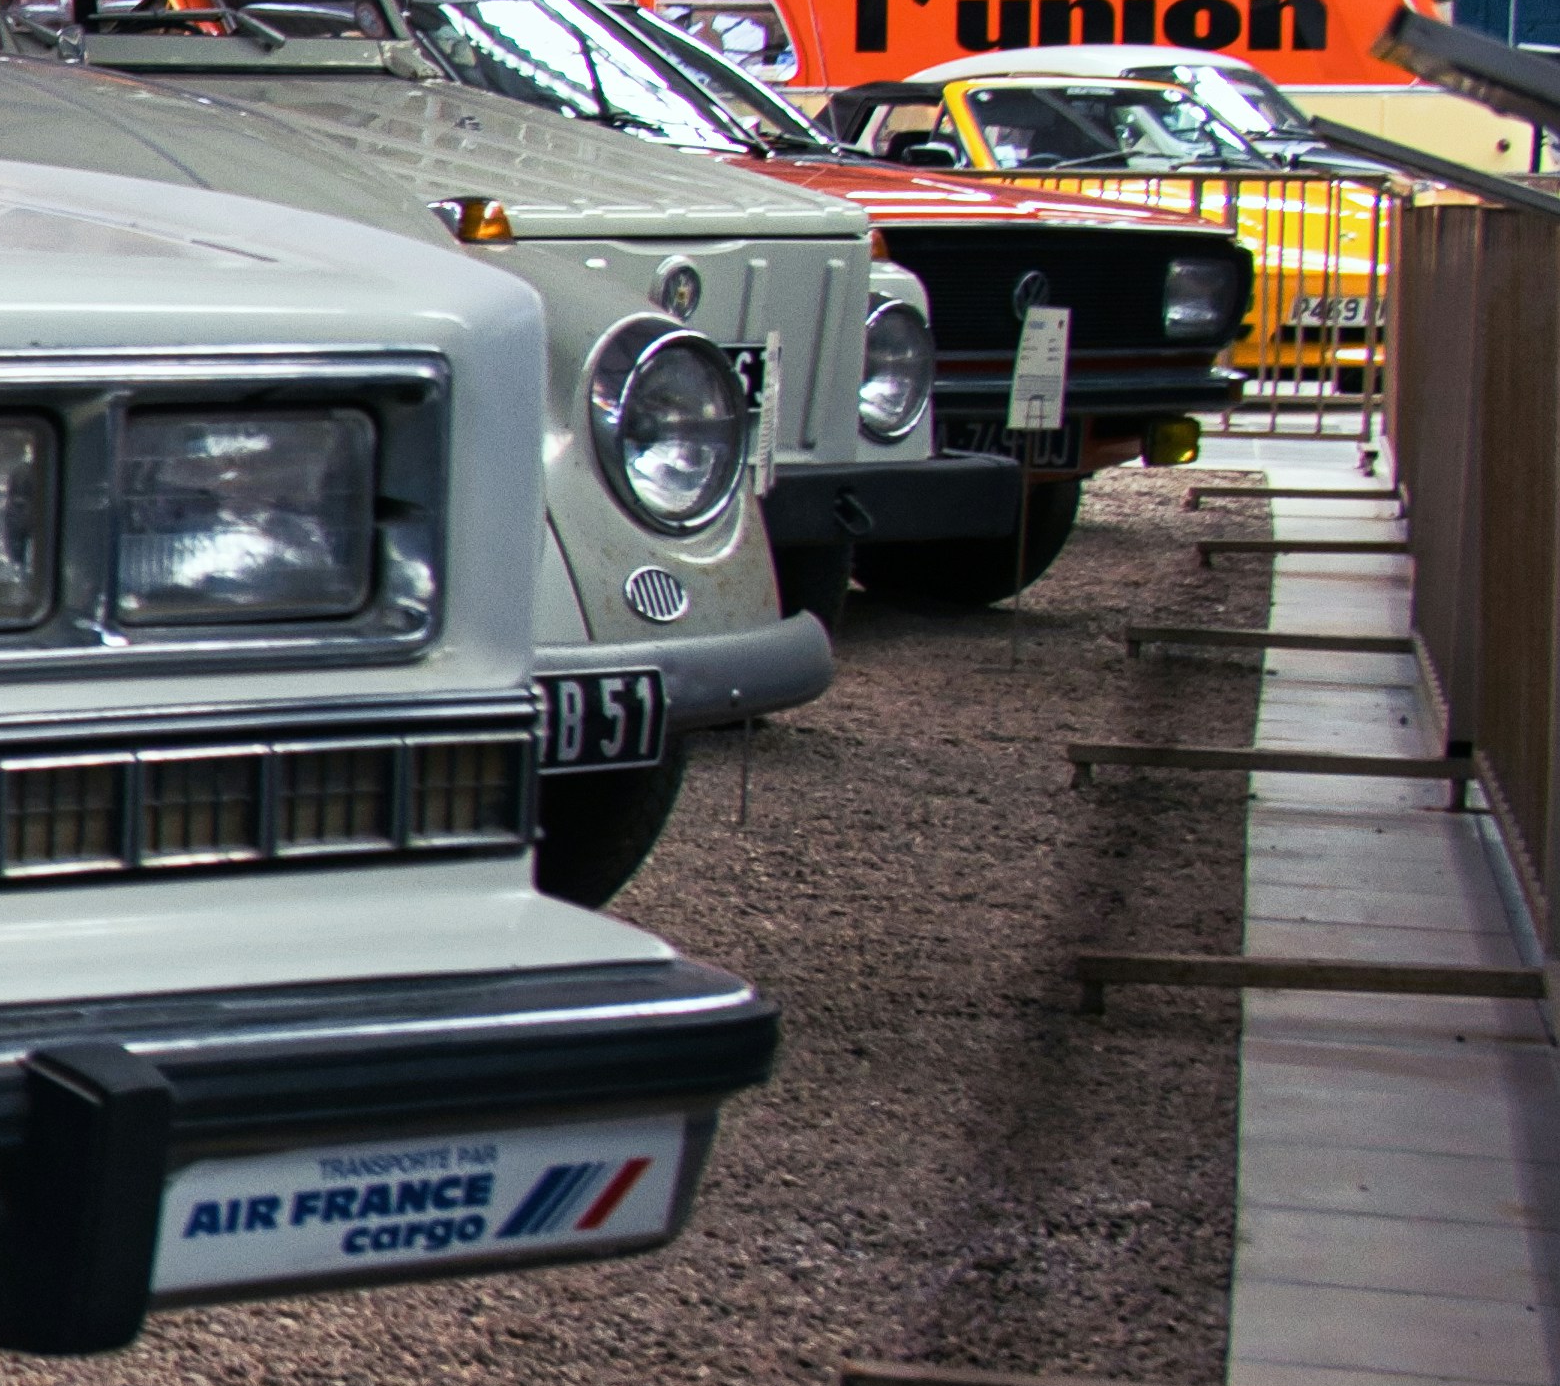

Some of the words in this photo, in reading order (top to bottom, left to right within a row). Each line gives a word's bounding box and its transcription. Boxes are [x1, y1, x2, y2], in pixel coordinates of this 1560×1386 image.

[184, 1197, 280, 1239] AIR
[290, 1172, 494, 1226] FRANCE
[341, 1213, 486, 1255] cargo
